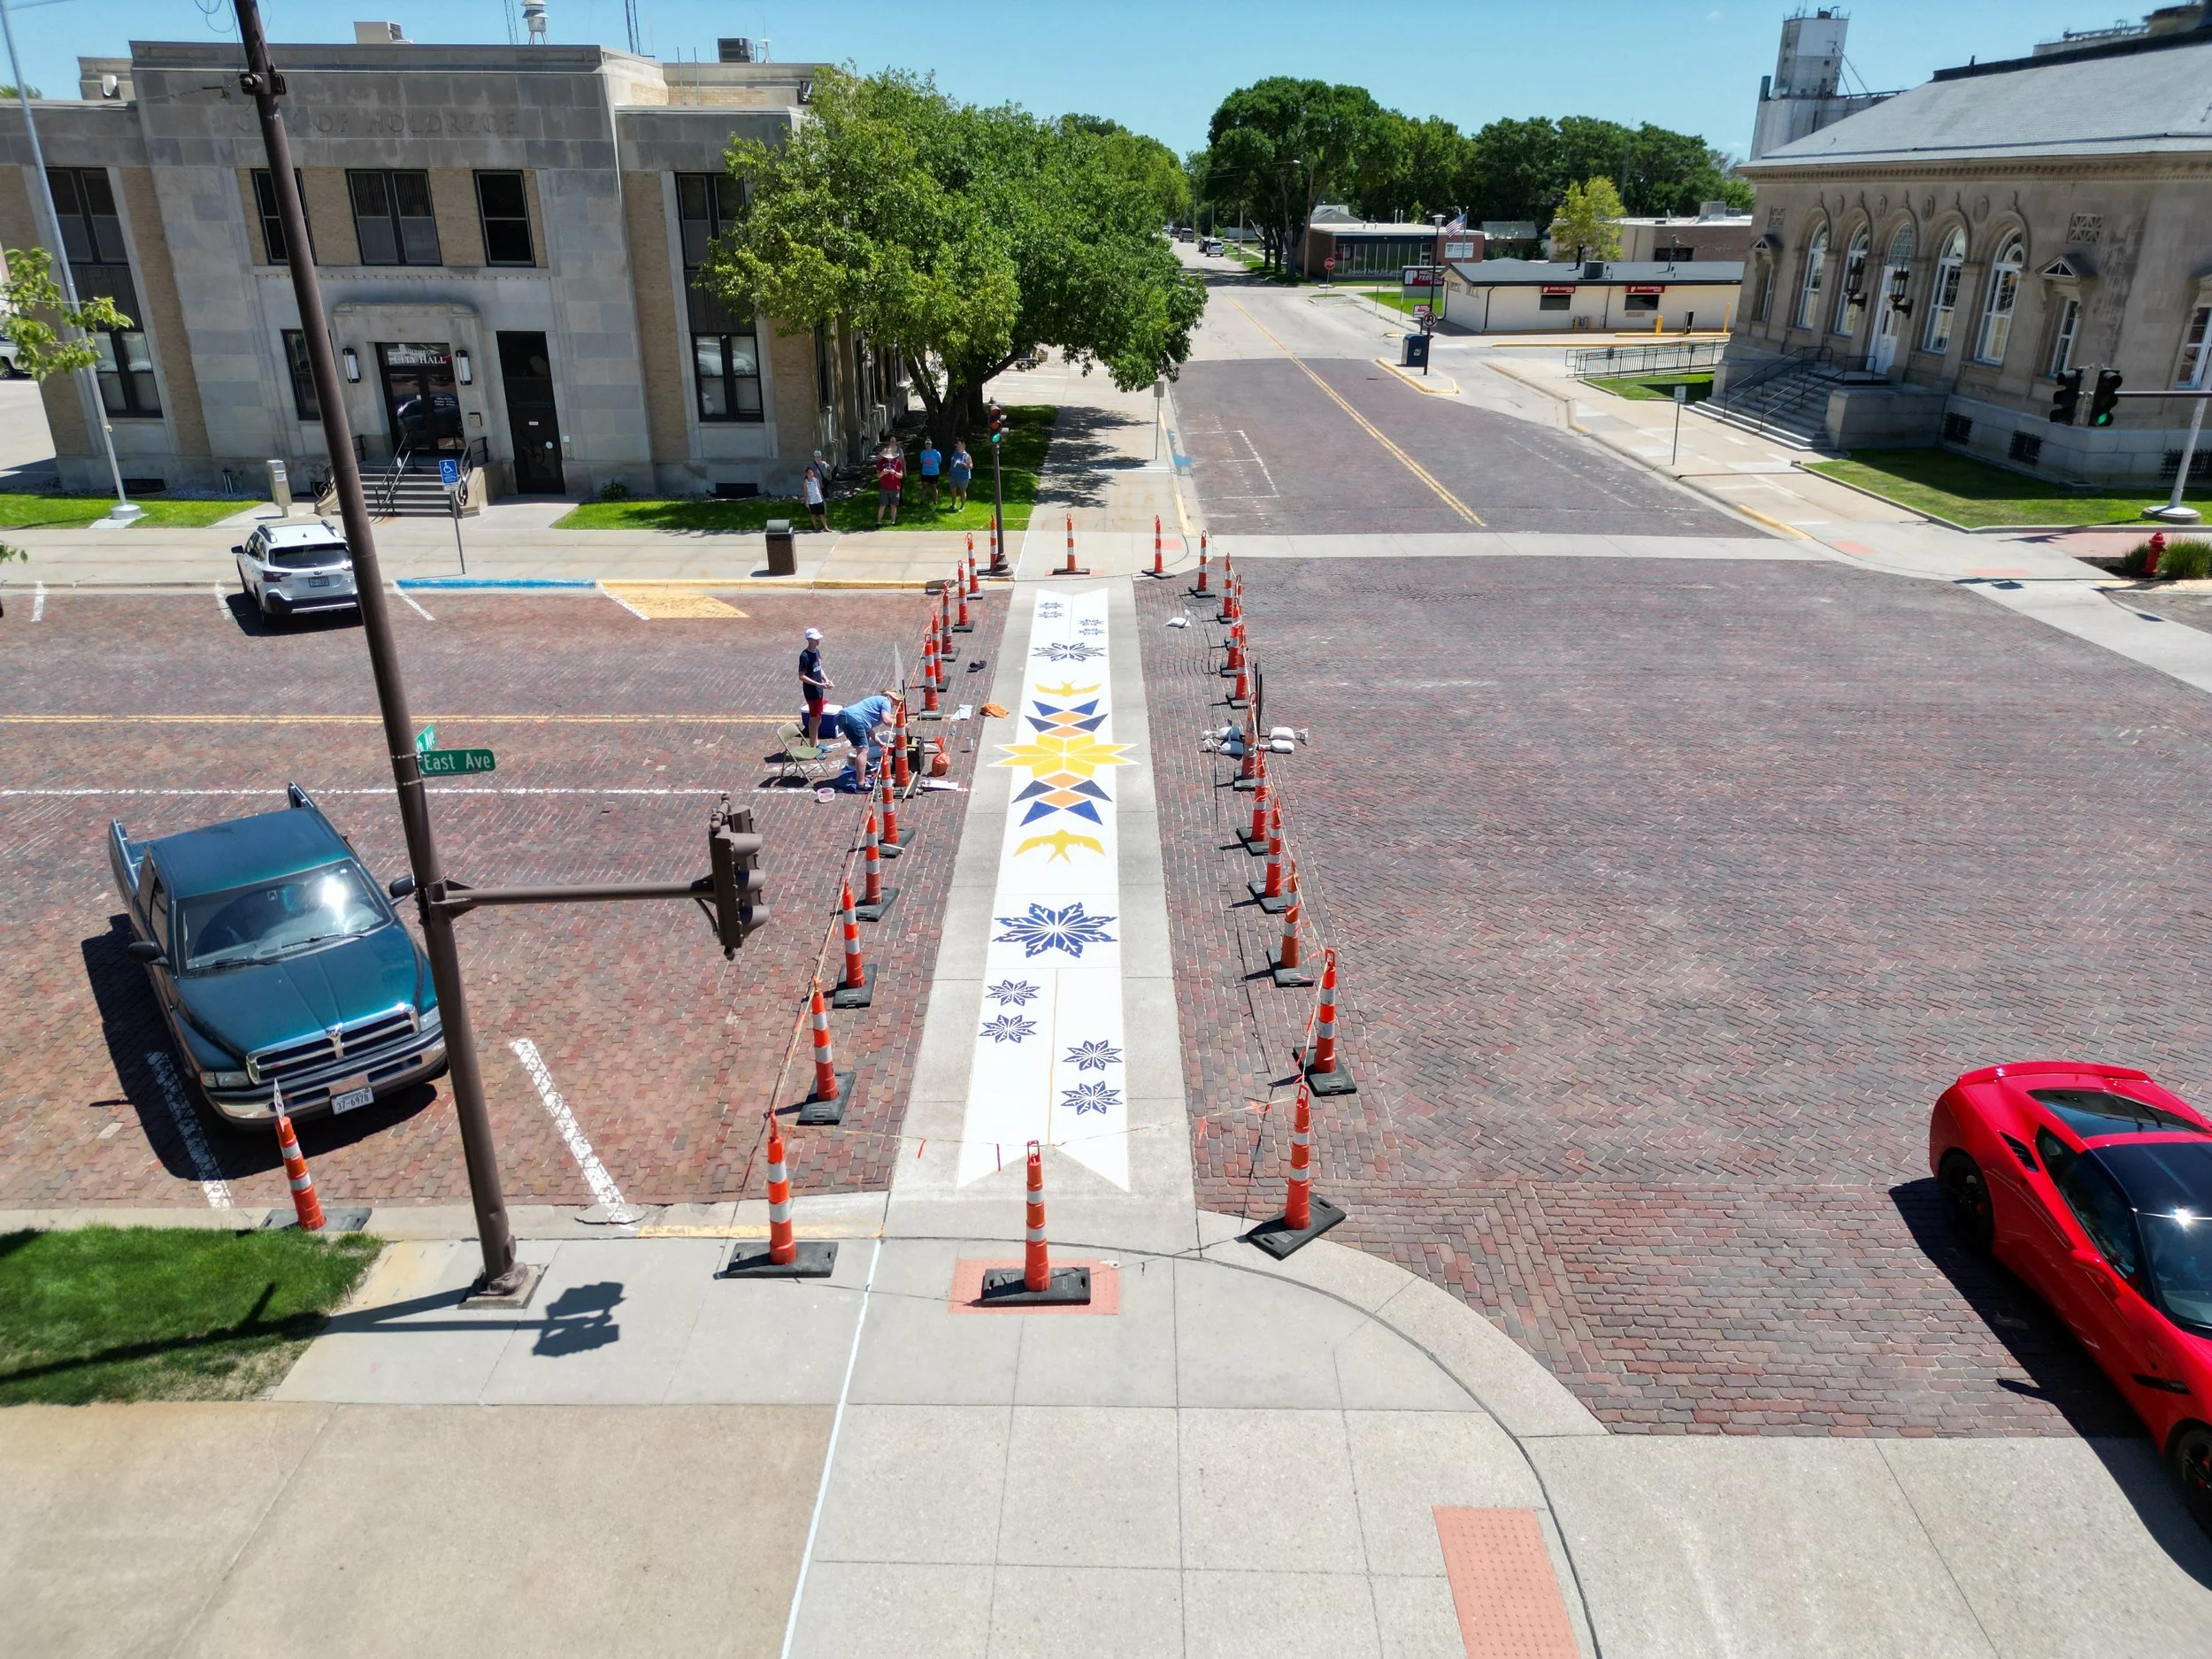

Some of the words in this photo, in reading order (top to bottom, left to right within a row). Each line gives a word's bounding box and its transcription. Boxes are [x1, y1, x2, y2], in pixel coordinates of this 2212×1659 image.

[234, 113, 298, 133] CY
[315, 113, 349, 134] OF
[424, 753, 456, 771] East
[465, 751, 490, 770] Ave
[336, 1094, 370, 1110] 37-6978
